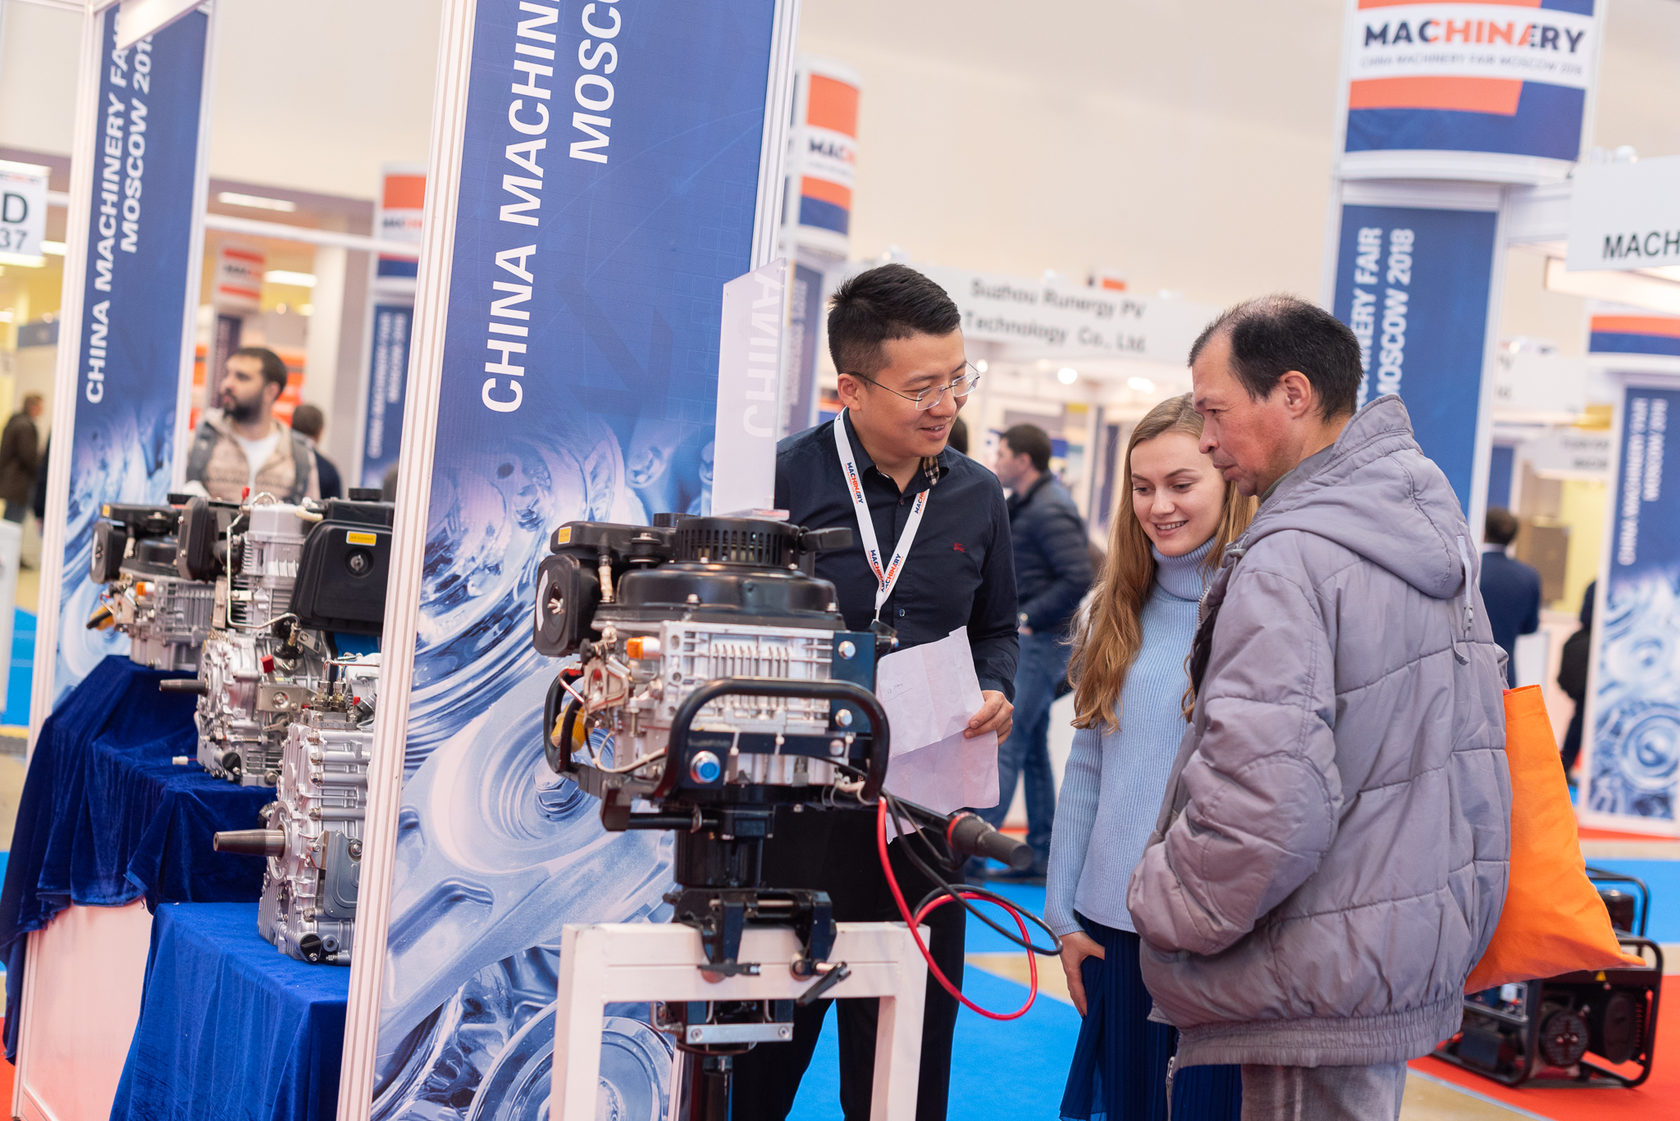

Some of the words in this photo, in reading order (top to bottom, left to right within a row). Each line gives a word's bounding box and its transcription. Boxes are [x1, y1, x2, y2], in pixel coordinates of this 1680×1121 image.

[500, 0, 560, 226] MACHIN
[569, 0, 622, 163] MOSC
[3, 193, 28, 224] D
[94, 92, 125, 292] MACHINERY
[120, 98, 148, 253] MOSCOW
[1354, 227, 1383, 285] FAIR
[1387, 228, 1415, 286] 2018
[86, 300, 110, 403] CHINA
[482, 244, 536, 413] CHINA
[964, 311, 1068, 345] Technology
